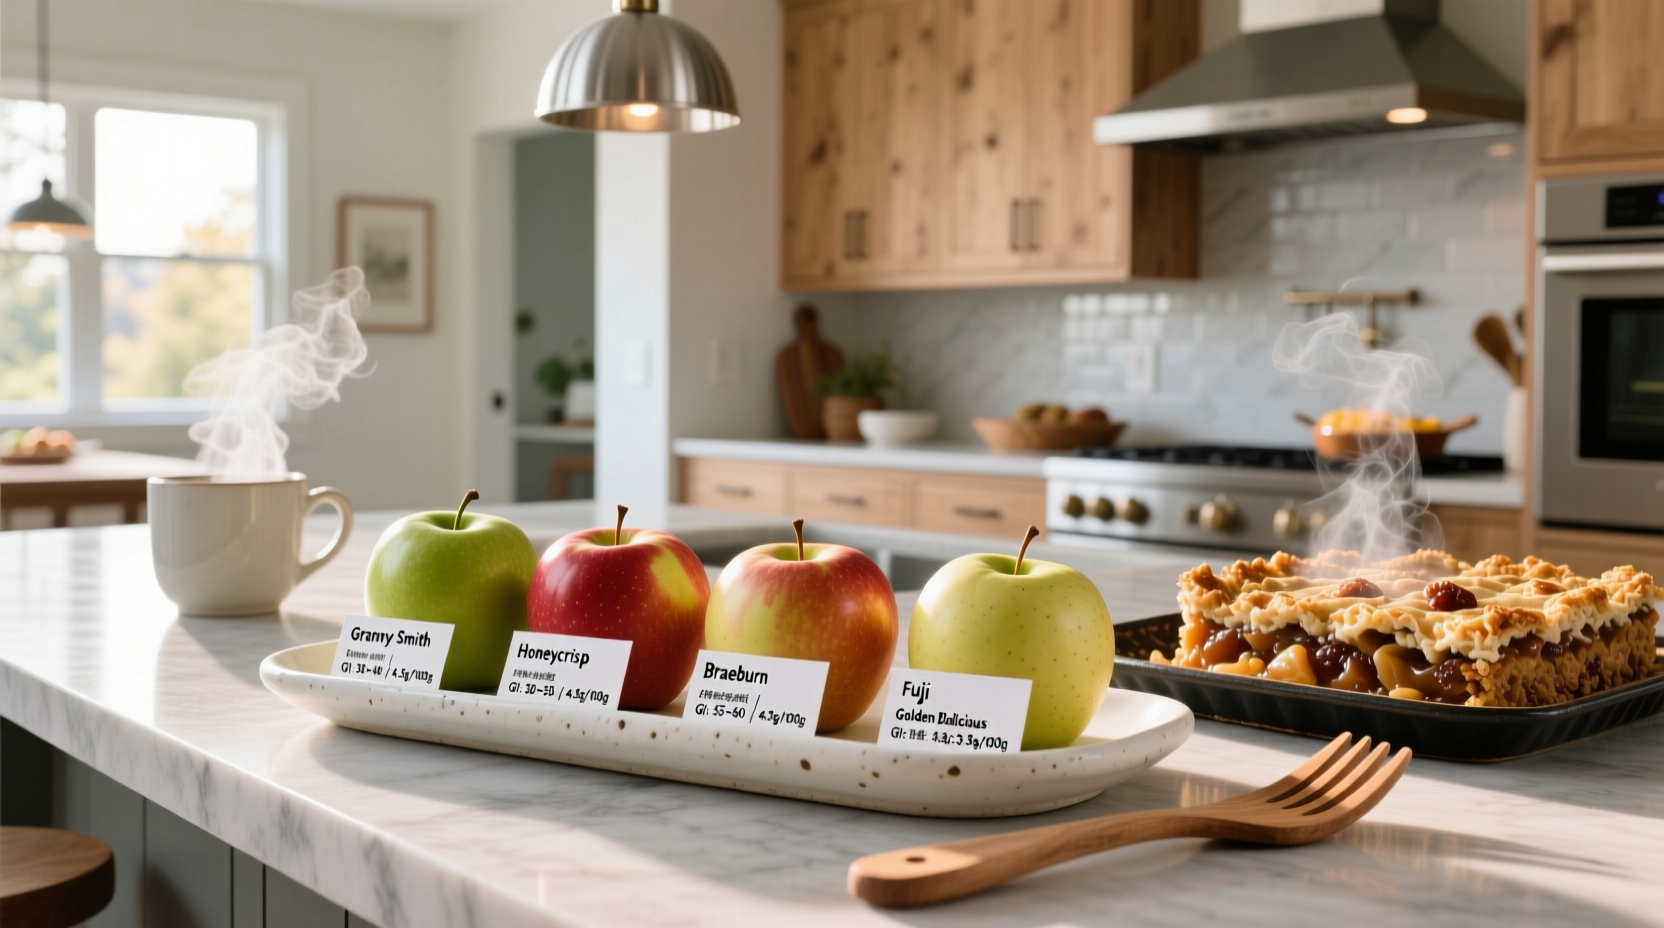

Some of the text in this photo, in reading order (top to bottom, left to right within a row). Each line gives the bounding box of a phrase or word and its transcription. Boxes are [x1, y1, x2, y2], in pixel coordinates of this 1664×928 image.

[396, 630, 431, 648] Smith
[517, 643, 590, 669] Honeycrisp
[703, 662, 768, 684] Braeburn
[902, 681, 932, 704] Fuji
[896, 708, 935, 724] Golden
